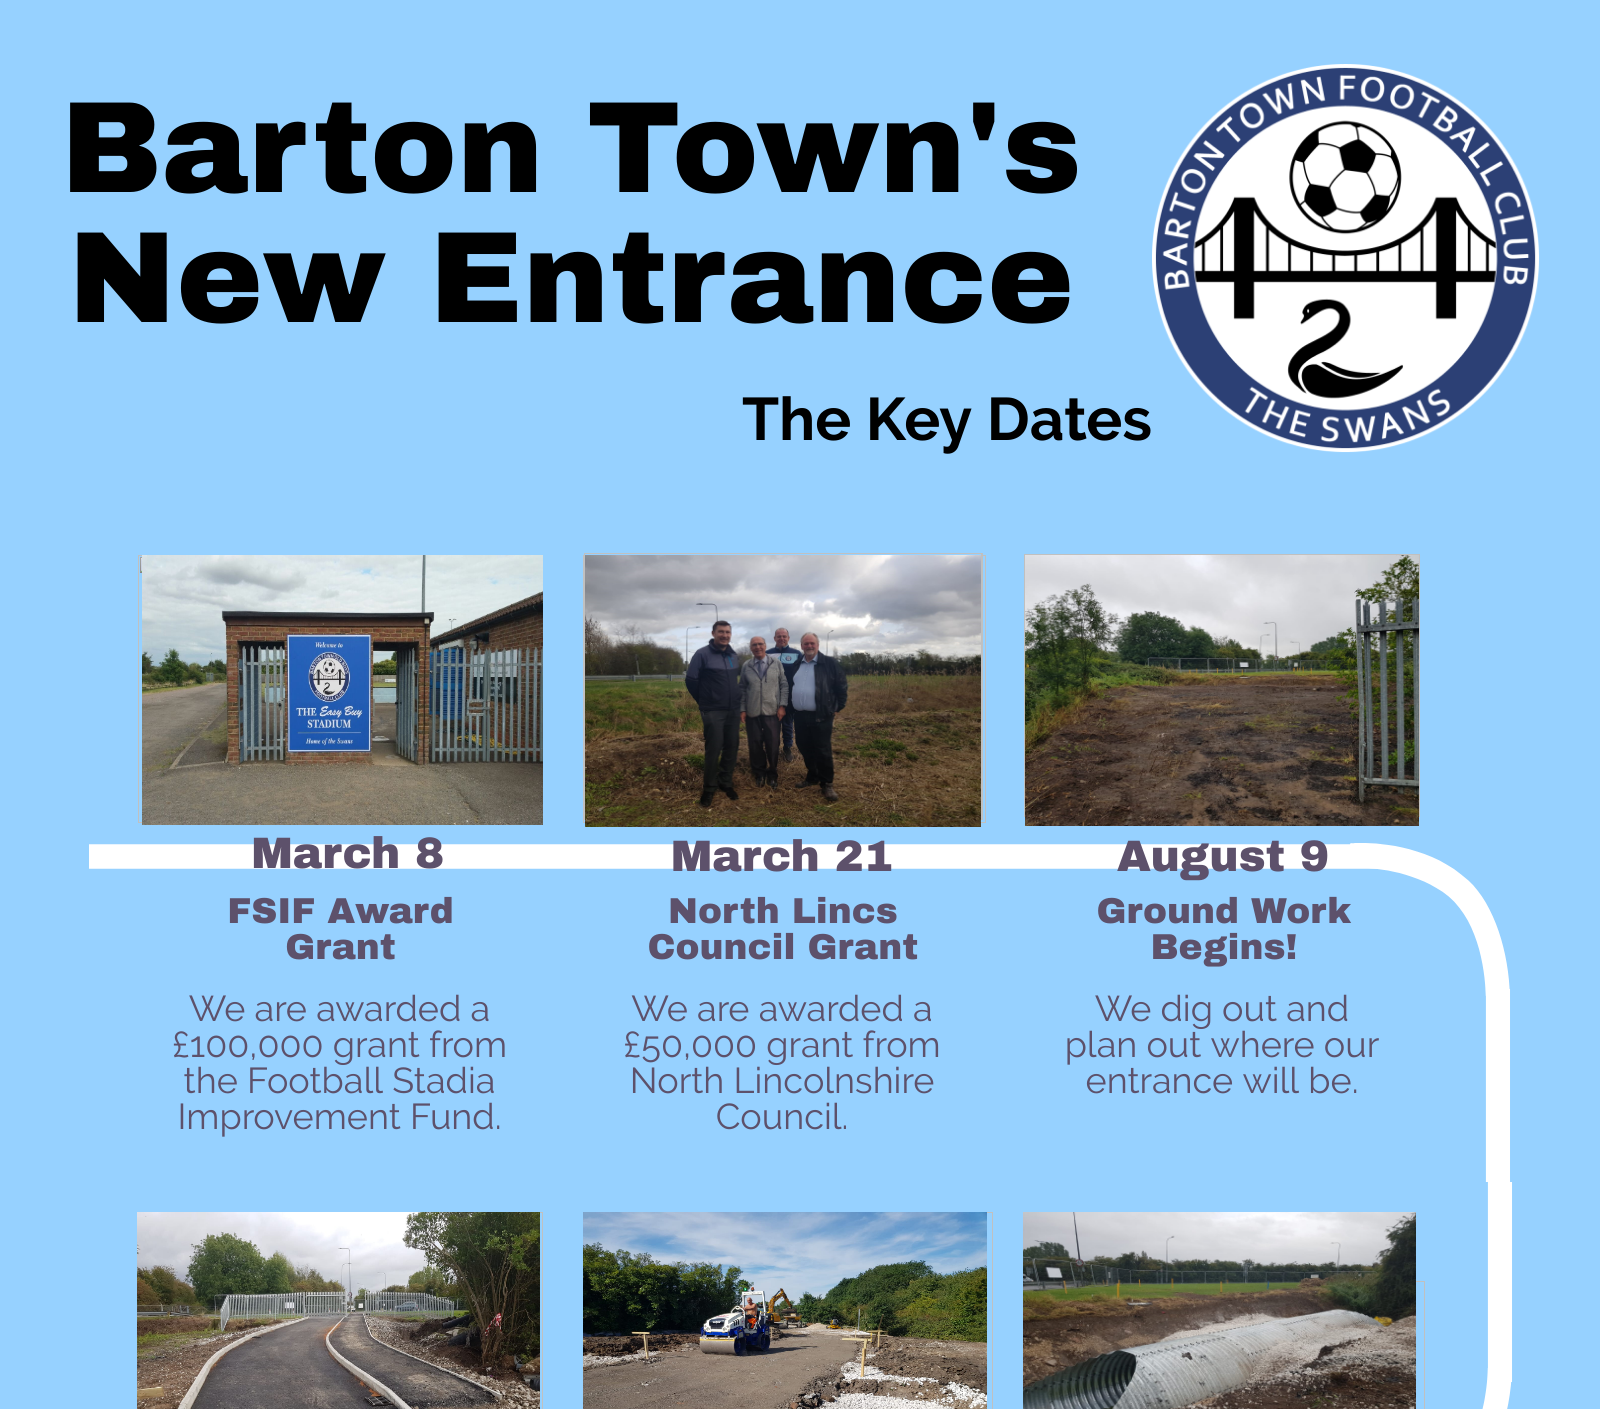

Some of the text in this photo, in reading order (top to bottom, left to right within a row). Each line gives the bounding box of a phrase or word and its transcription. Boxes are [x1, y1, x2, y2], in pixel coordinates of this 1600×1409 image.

[69, 101, 1078, 195] Barton Town's
[1164, 74, 1530, 290] BARTON TOWN FOOTBALL CLUB
[76, 231, 1071, 325] New Entrance
[742, 395, 1152, 455] The Key Dates
[1243, 386, 1453, 443] THE SWANS
[296, 705, 363, 719] THE Easy Buy
[307, 719, 352, 729] STADIUM
[253, 835, 444, 870] March 8
[672, 838, 892, 873] March 21
[1116, 839, 1328, 881] August 9
[229, 896, 453, 925] FSIF Award
[669, 896, 898, 925] North Lincs
[1097, 896, 1352, 925] Ground Work
[286, 933, 396, 961] Grant
[648, 932, 918, 961] Council Grant
[1152, 932, 1297, 968] Begins!
[1094, 994, 1348, 1030] We dig out and
[173, 1029, 506, 1066] £100,000 grant from
[624, 1029, 939, 1066] £50,000 grant from
[183, 1066, 495, 1095] the Football Stadia
[632, 1066, 934, 1095] North Lincolnshire
[1086, 1066, 1357, 1095] entrance will be.
[716, 1102, 847, 1131] Council.
